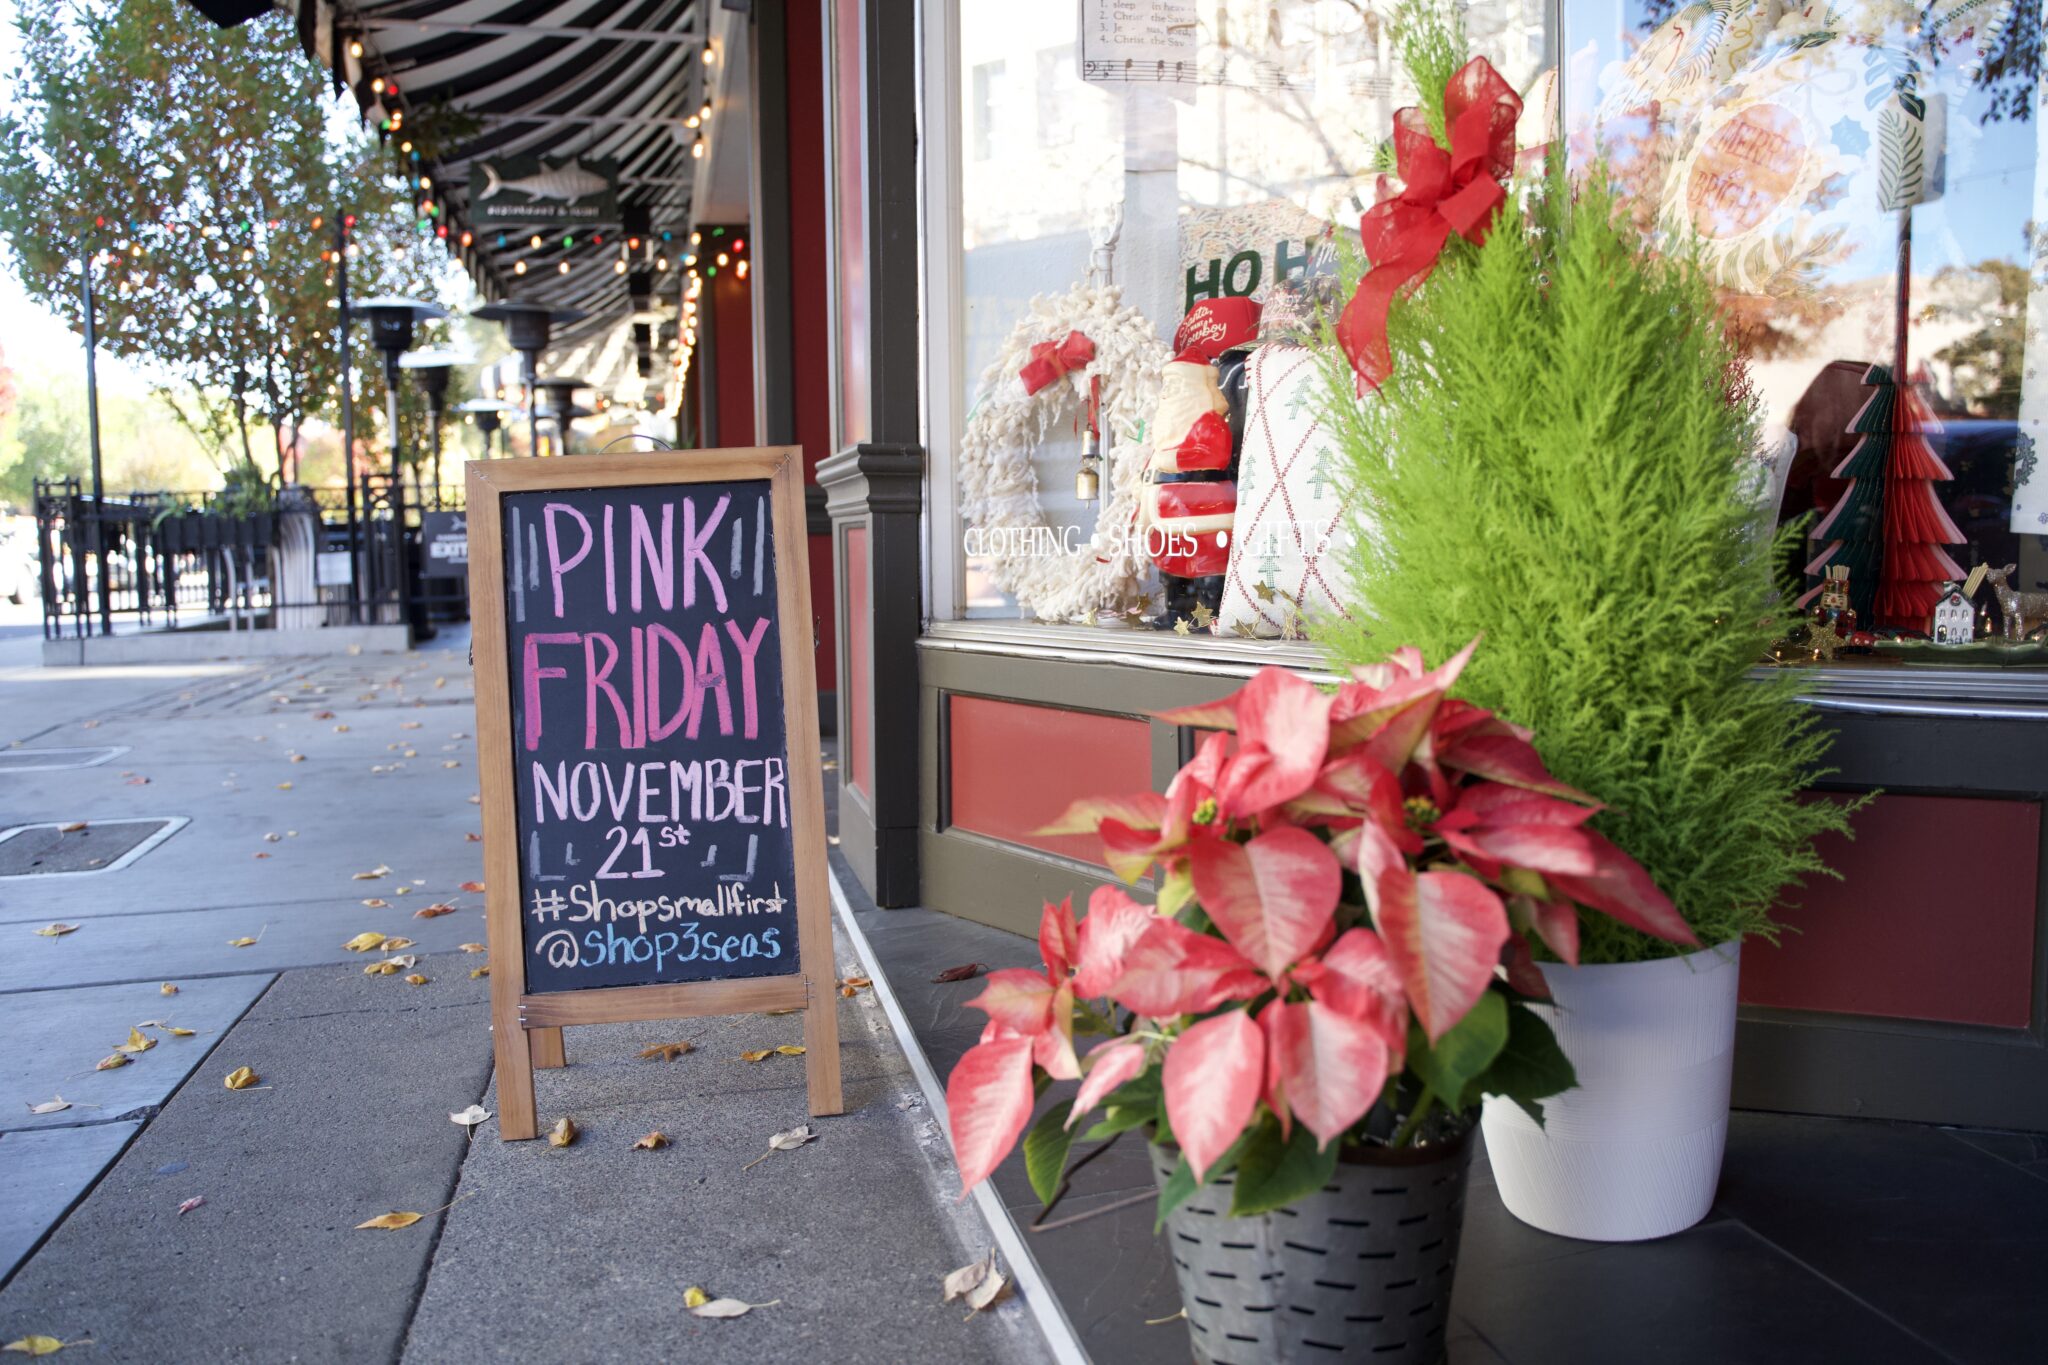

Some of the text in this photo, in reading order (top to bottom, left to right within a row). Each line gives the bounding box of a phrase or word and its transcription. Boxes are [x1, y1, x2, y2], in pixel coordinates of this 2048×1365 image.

[1113, 34, 1144, 44] Christ
[1150, 36, 1165, 45] the
[1151, 12, 1166, 22] the
[544, 492, 732, 618] PINK
[963, 519, 1333, 559] CLOTHING SHOES GIFTS
[524, 617, 770, 751] FRIDAY
[532, 757, 788, 829] NOVEMBER
